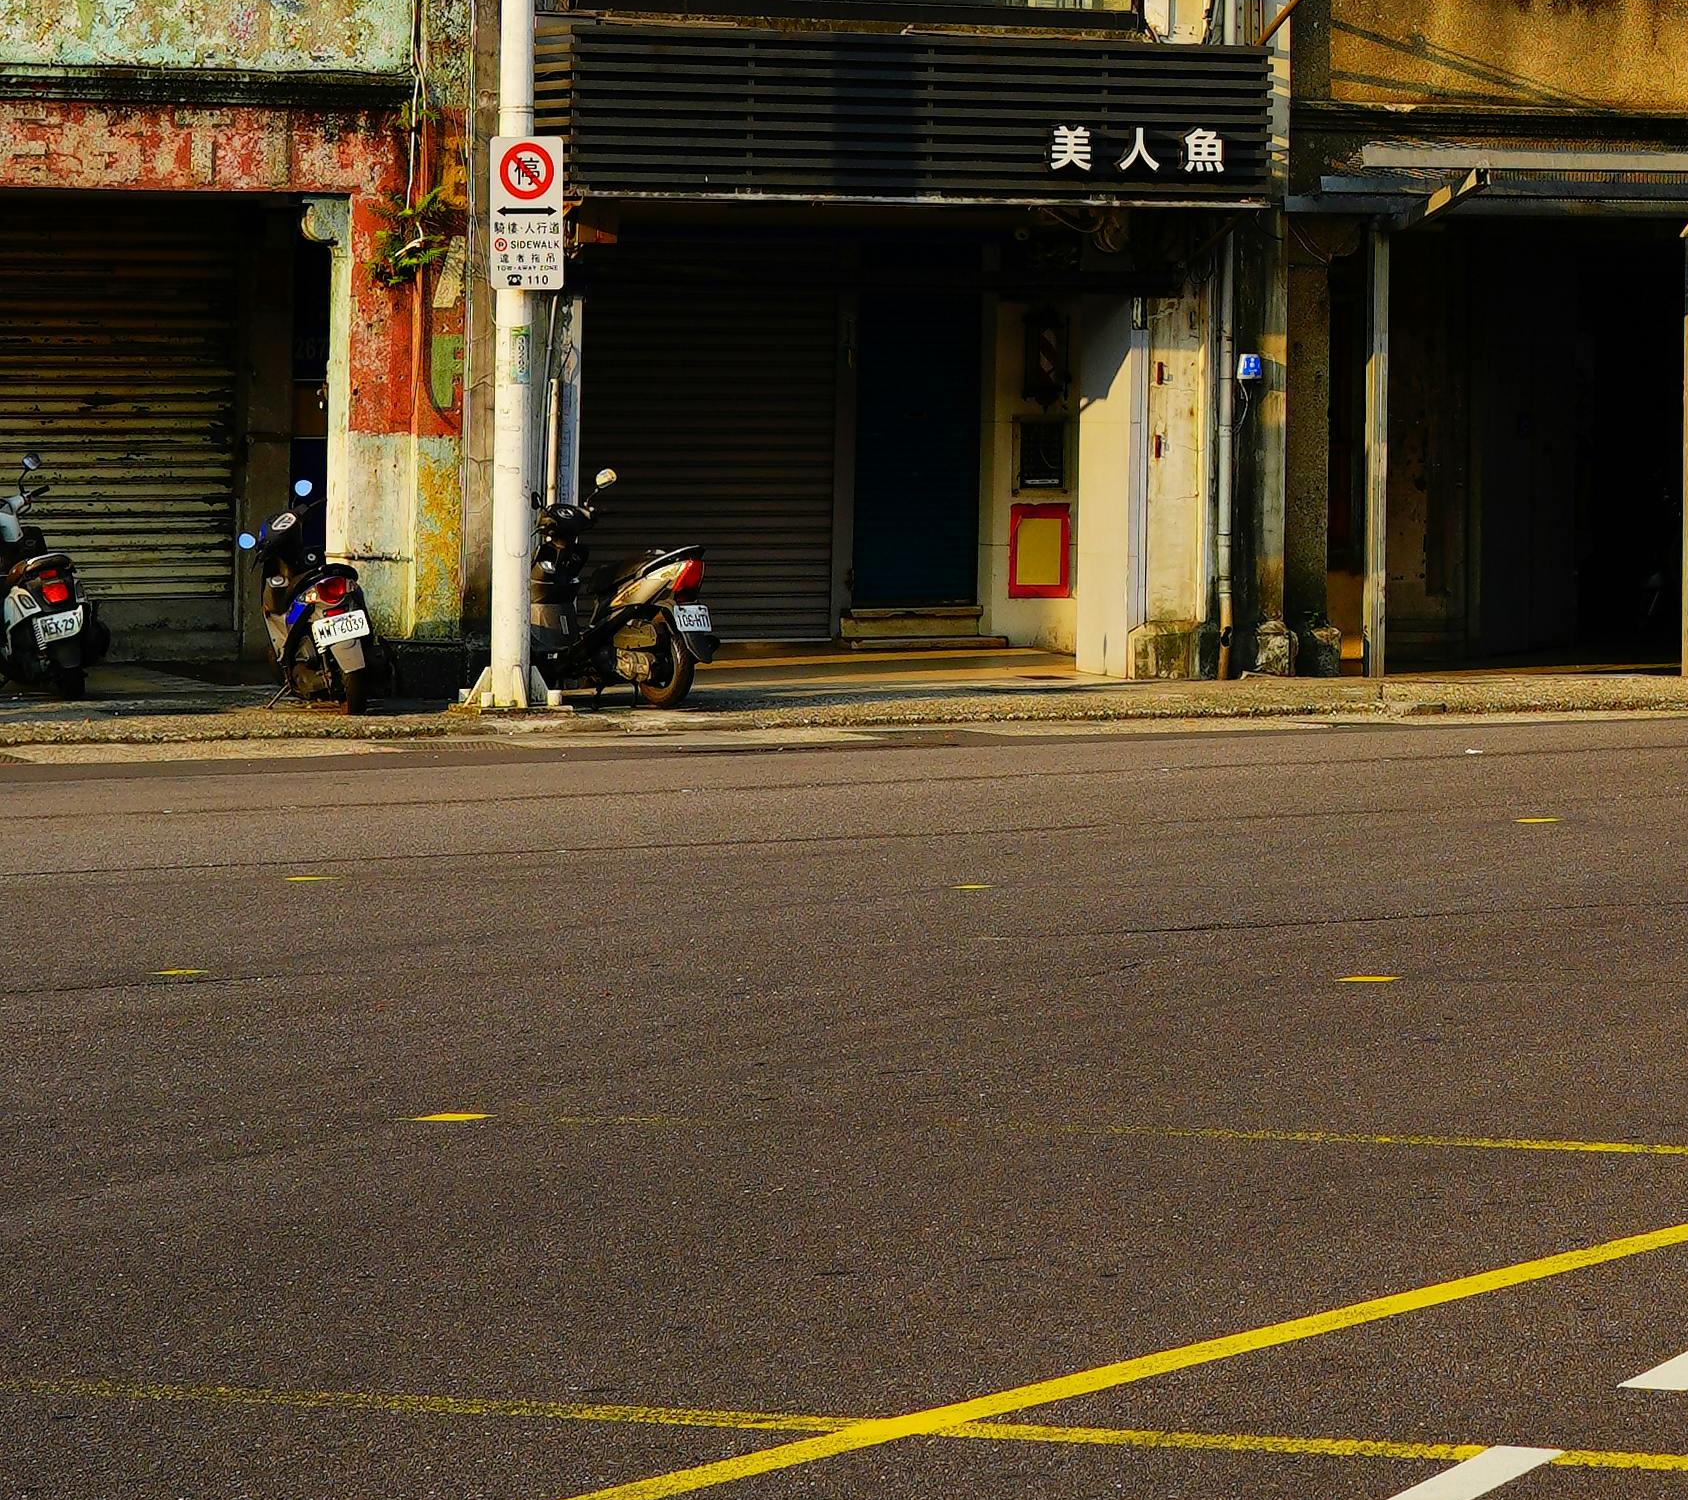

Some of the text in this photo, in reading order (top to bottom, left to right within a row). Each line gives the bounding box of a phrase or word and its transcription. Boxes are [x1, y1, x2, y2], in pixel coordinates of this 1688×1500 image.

[1048, 125, 1225, 173] 美人魚
[511, 240, 560, 249] SIDEWALK
[528, 275, 549, 285] 110
